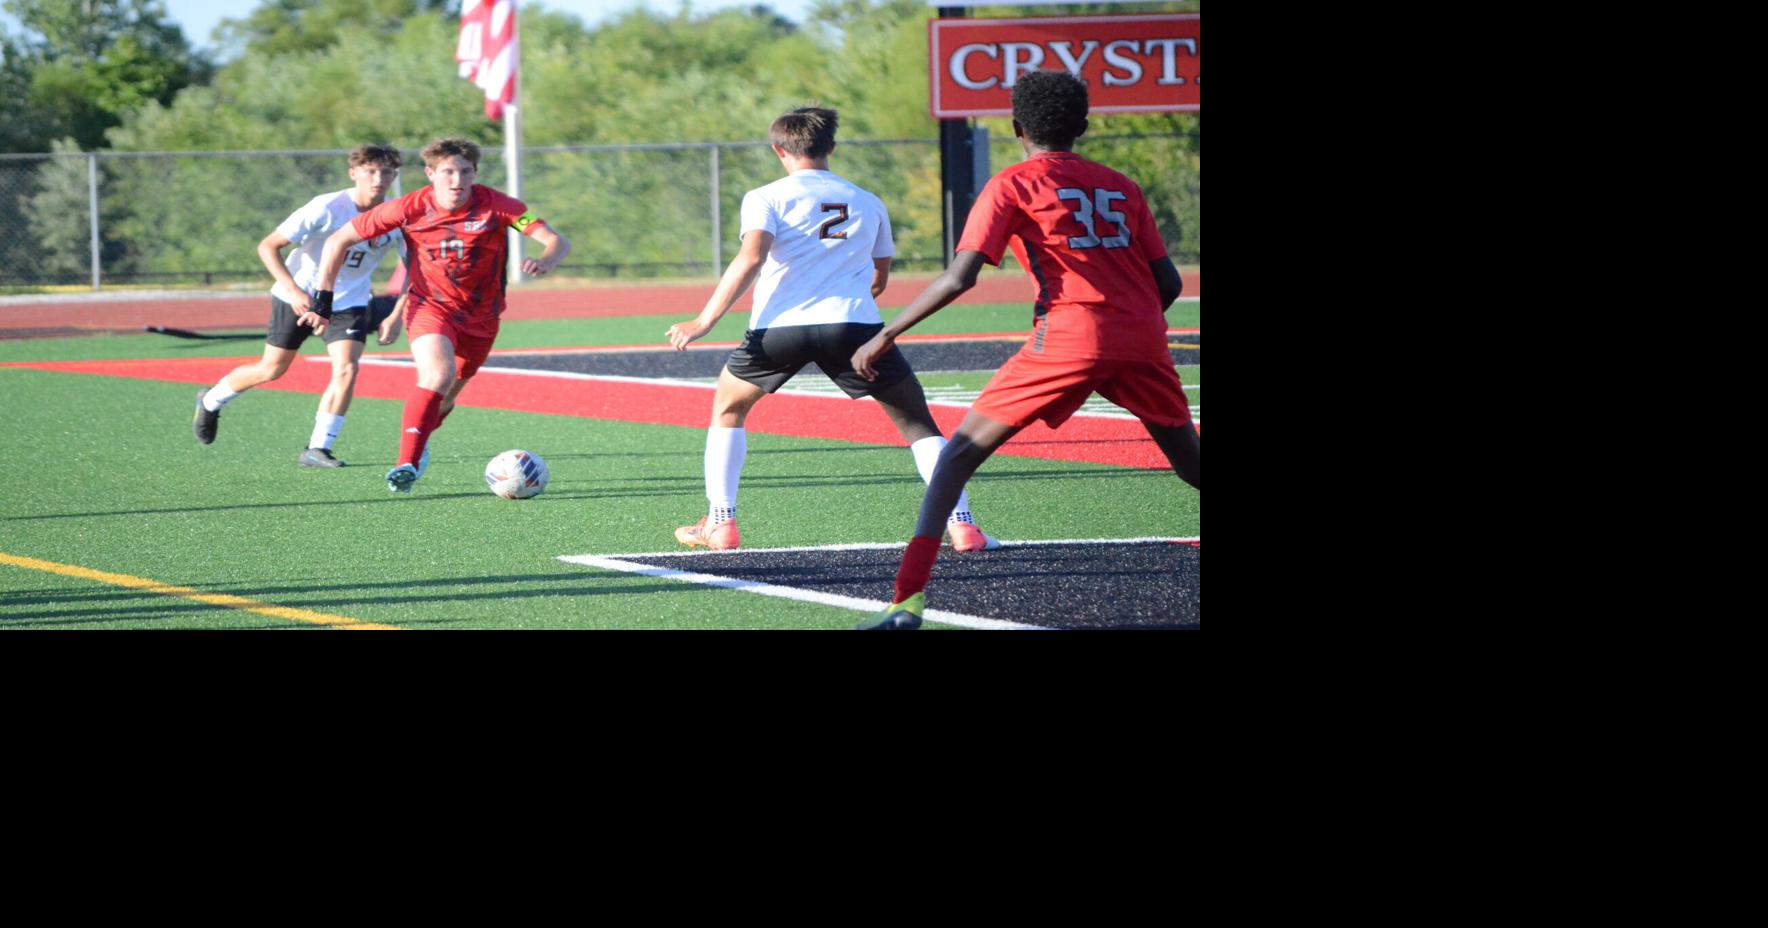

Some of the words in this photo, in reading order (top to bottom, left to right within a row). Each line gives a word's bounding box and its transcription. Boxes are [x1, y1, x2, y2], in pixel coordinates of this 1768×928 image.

[949, 37, 1200, 90] CRYST
[820, 203, 848, 239] 2
[1056, 187, 1131, 249] 35
